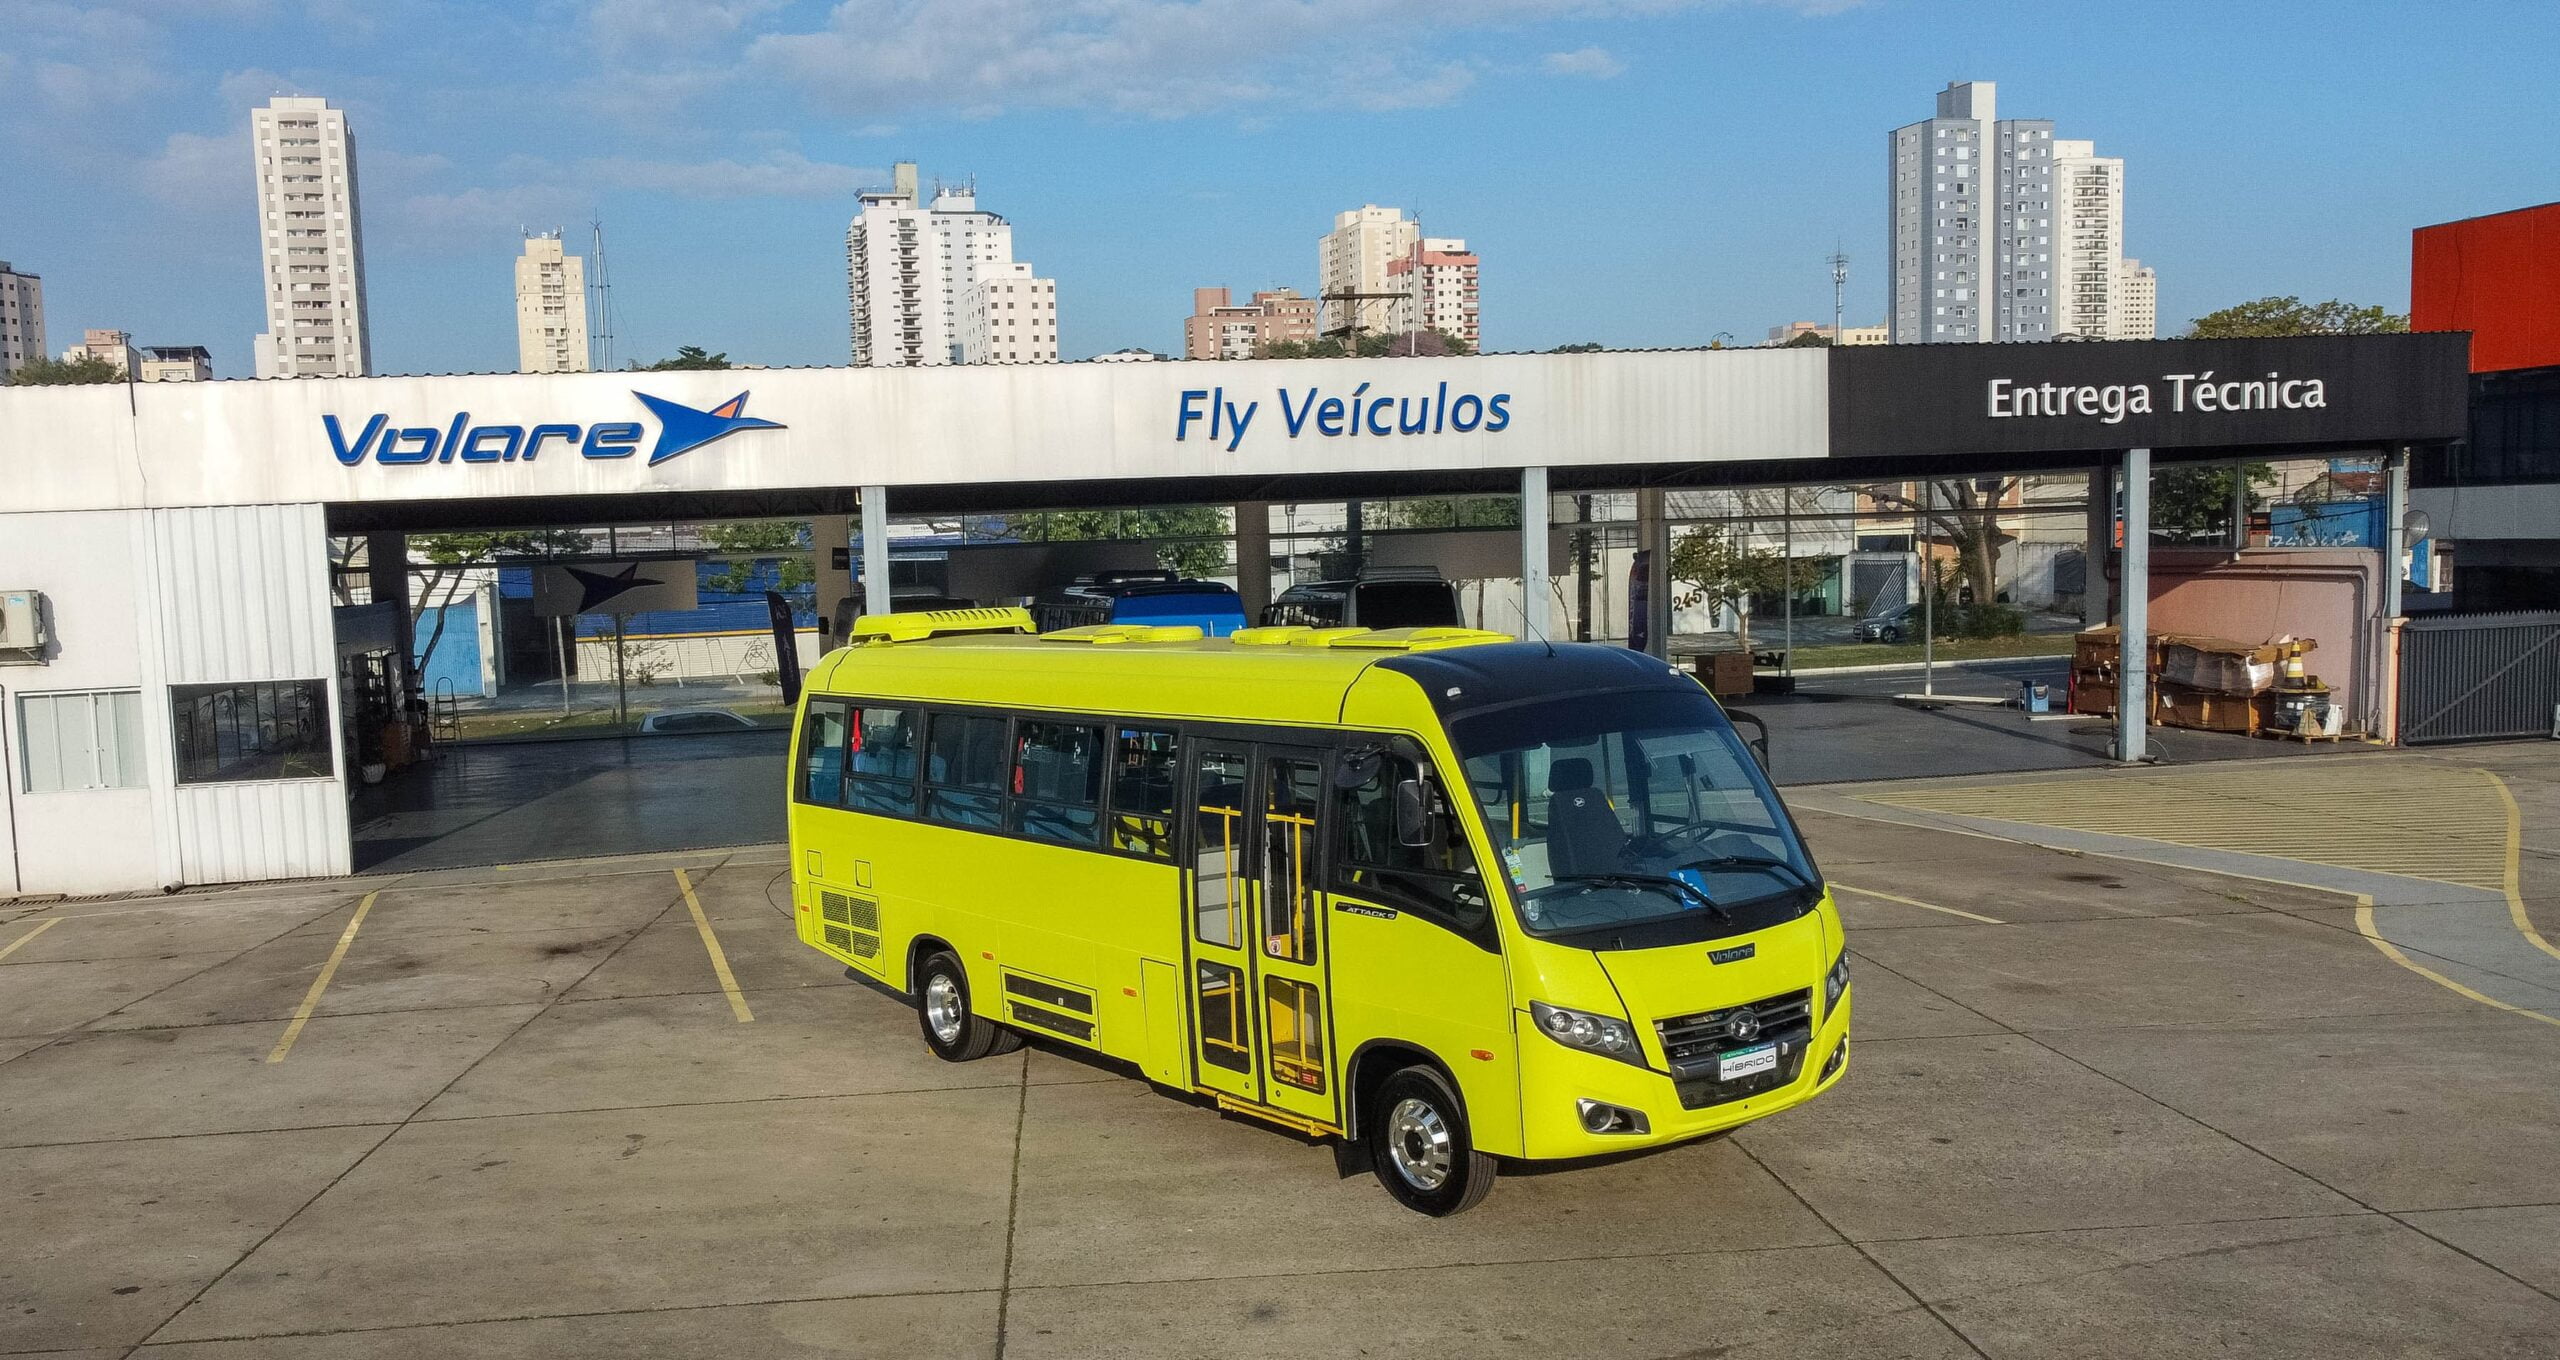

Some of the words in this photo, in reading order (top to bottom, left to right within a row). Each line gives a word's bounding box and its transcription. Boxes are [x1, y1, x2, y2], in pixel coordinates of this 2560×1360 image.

[1988, 378, 2152, 424] Entrega
[2162, 370, 2326, 413] Técnica
[1176, 386, 1258, 452] Fly
[1277, 381, 1511, 438] Veículos
[321, 411, 644, 466] Volare
[1673, 588, 1703, 612] 245
[1347, 908, 1387, 918] ATTACK
[1711, 946, 1753, 961] Volare
[1722, 1054, 1775, 1075] HÍBRIDO
